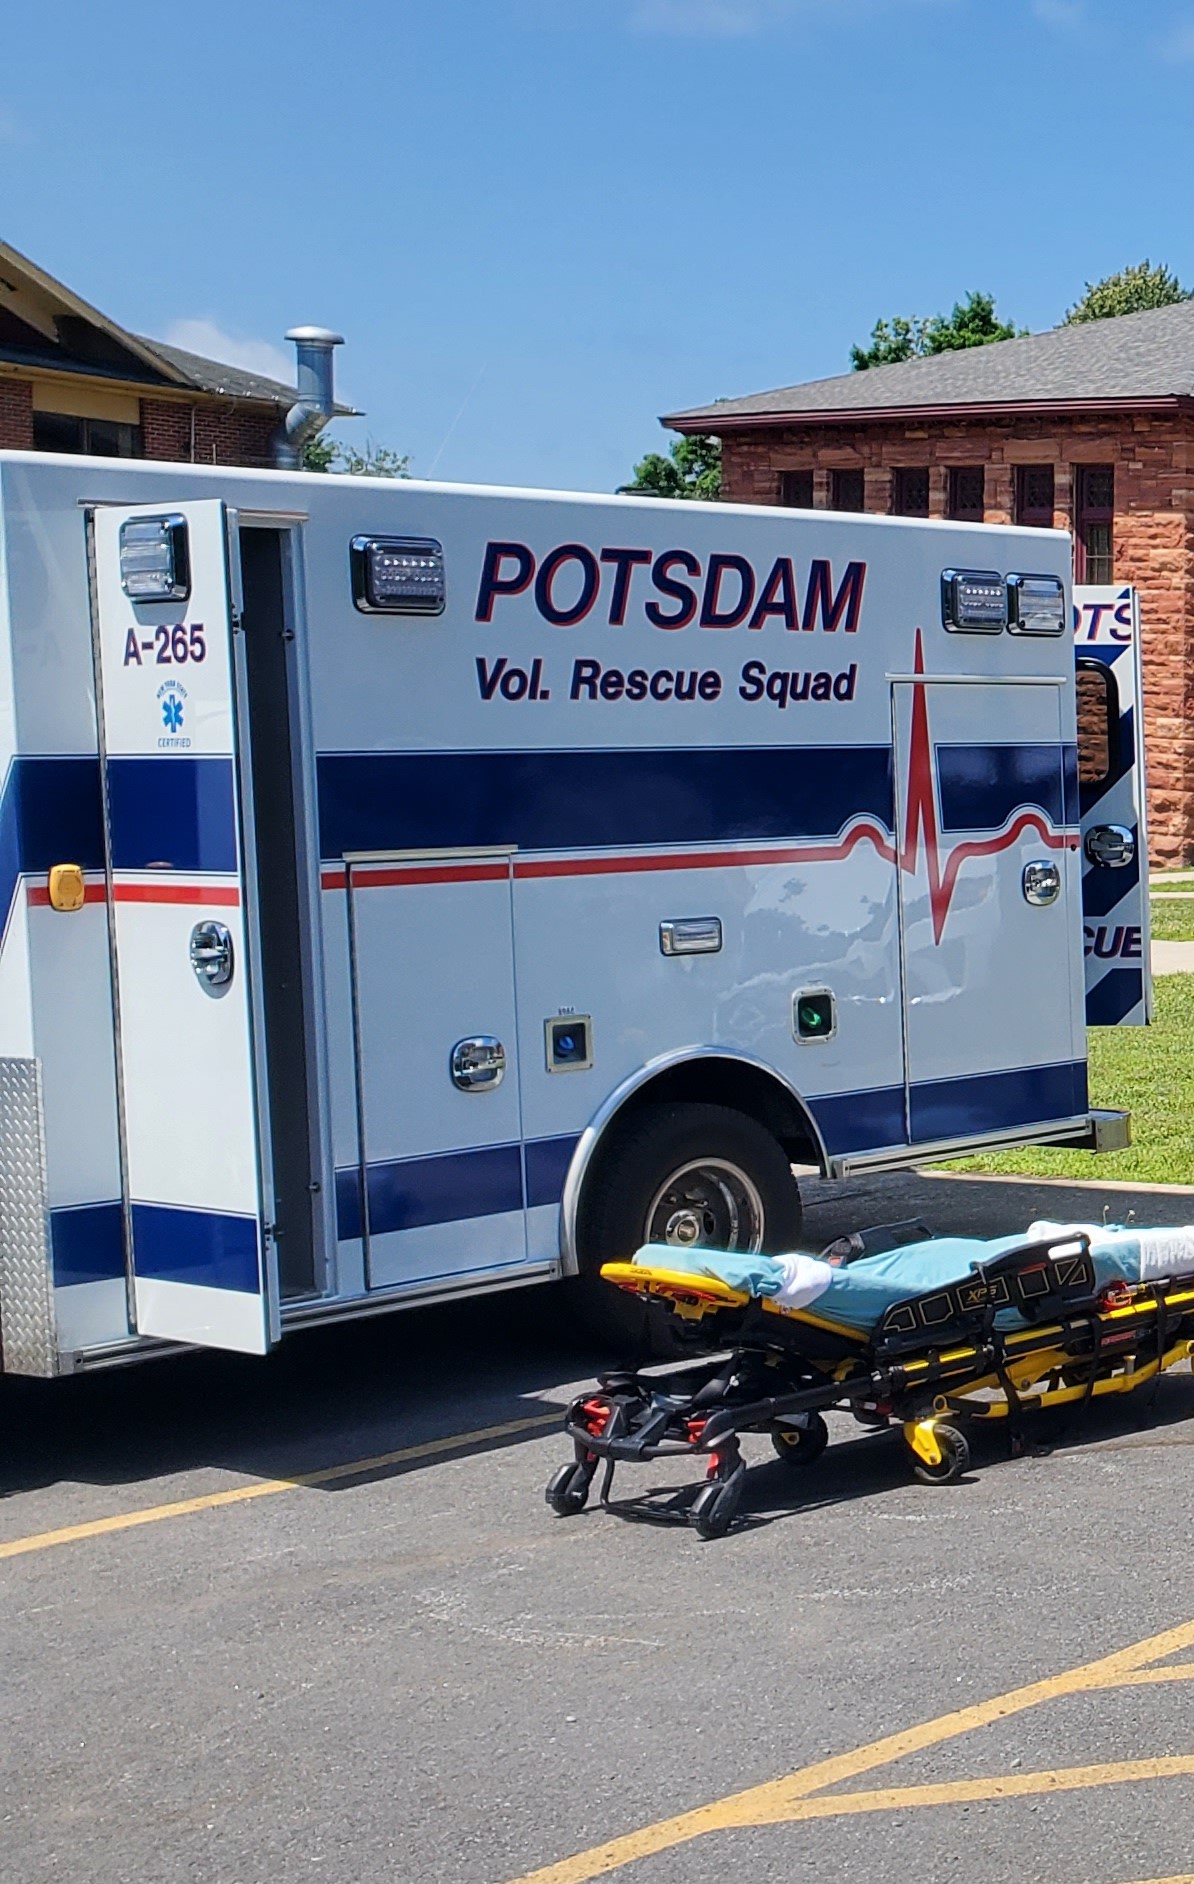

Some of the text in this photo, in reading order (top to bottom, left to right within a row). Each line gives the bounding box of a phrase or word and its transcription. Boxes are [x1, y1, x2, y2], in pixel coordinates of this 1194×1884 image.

[474, 541, 867, 633] POTSDAM
[1073, 602, 1131, 641] TS
[123, 622, 206, 666] A-265
[475, 656, 858, 709] Vol. Rescue Squad
[157, 737, 192, 748] CERTIFIED
